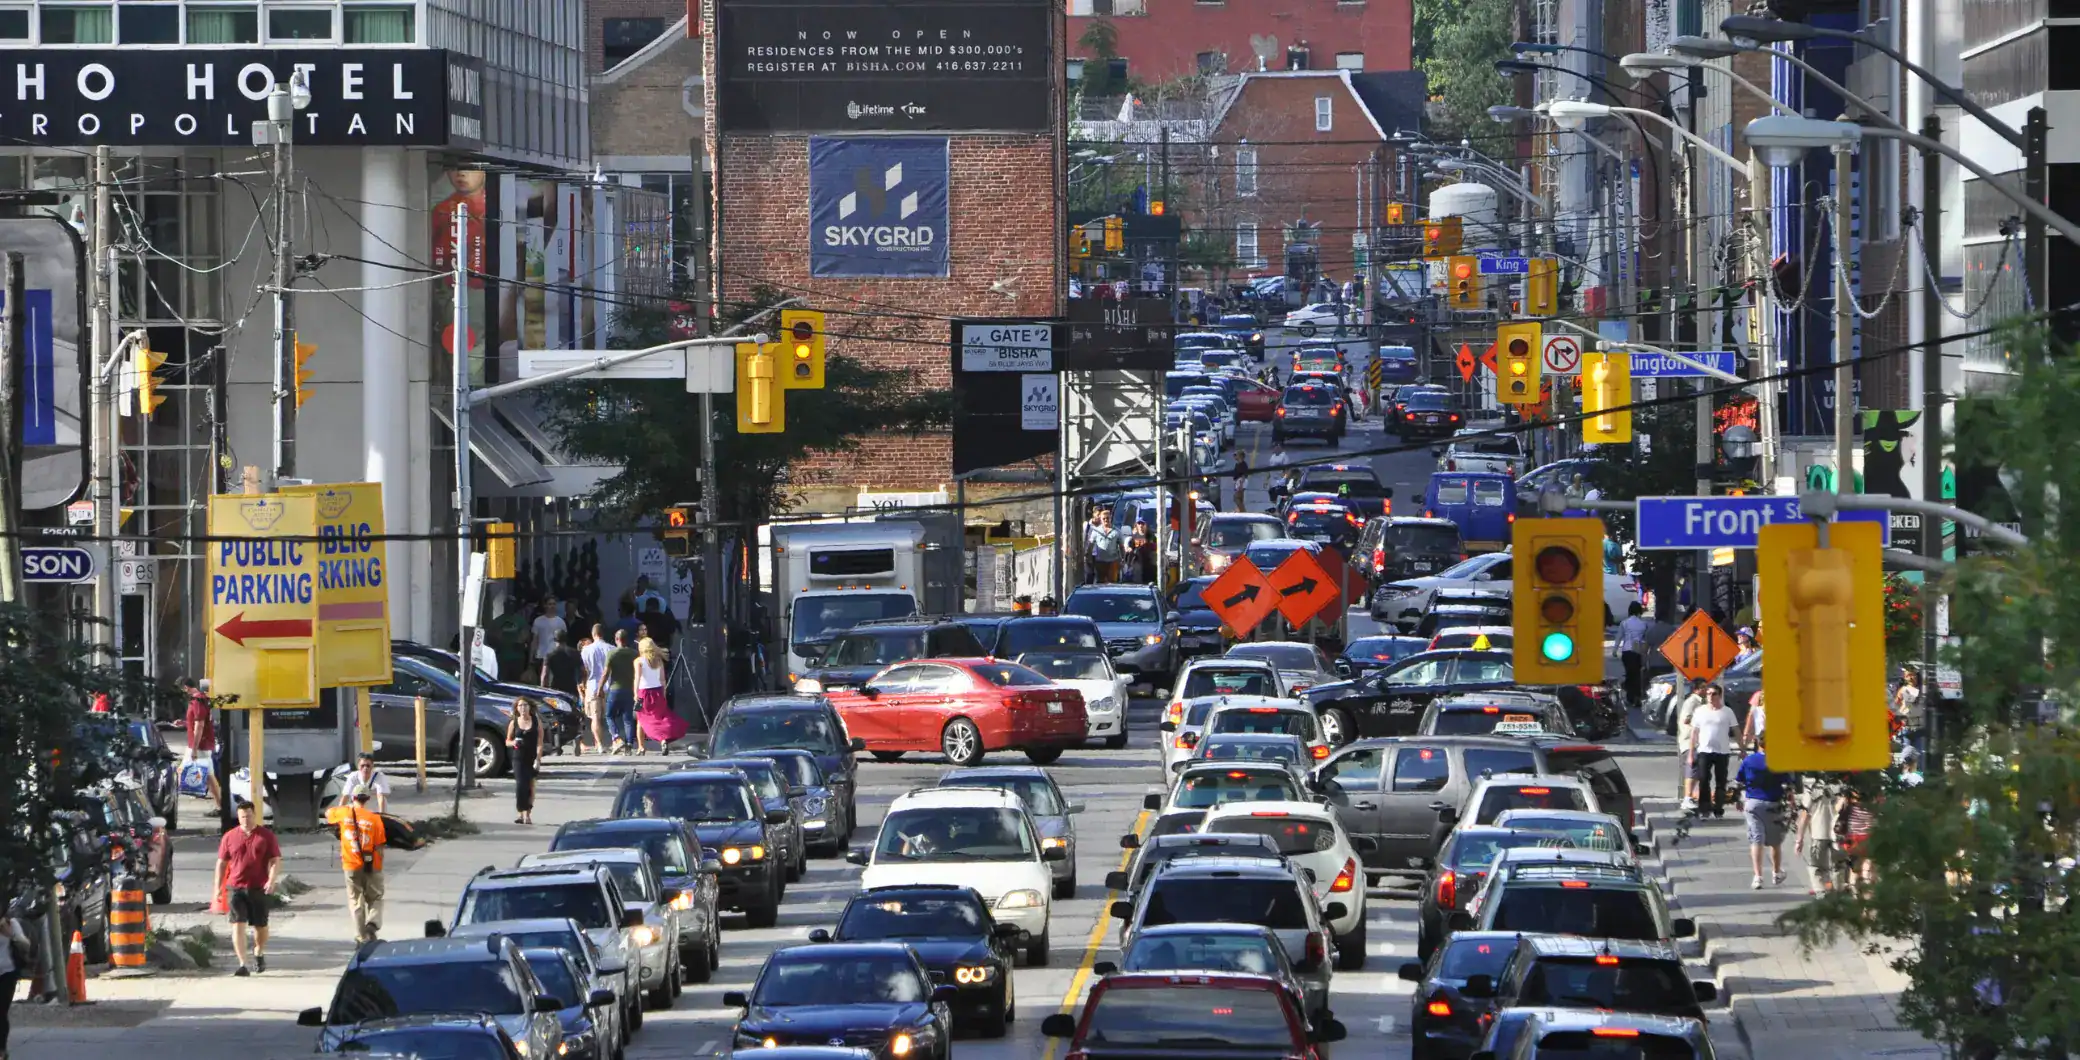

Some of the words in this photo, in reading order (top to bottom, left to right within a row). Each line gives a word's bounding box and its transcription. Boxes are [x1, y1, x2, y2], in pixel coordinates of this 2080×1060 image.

[798, 31, 858, 40] NOW
[892, 30, 971, 39] OPEN
[747, 46, 834, 56] RESIDENCES
[841, 46, 879, 55] FROM
[885, 45, 911, 55] THE
[918, 46, 943, 55] MID
[949, 45, 1023, 56] $300,000's
[747, 62, 815, 72] REGISTER
[821, 62, 837, 72] AT
[846, 61, 926, 71] BISHA.COM
[936, 61, 1022, 71] 416.637.2211
[187, 63, 414, 101] HOTEL
[858, 104, 894, 114] Lifetime
[1496, 259, 1520, 272] King
[990, 329, 1032, 342] GATE
[1035, 329, 1049, 341] #2
[1685, 503, 1775, 535] Front
[318, 523, 372, 554] BLIC
[221, 538, 303, 567] PUBLIC
[24, 555, 82, 575] SON
[213, 572, 312, 605] PARKING
